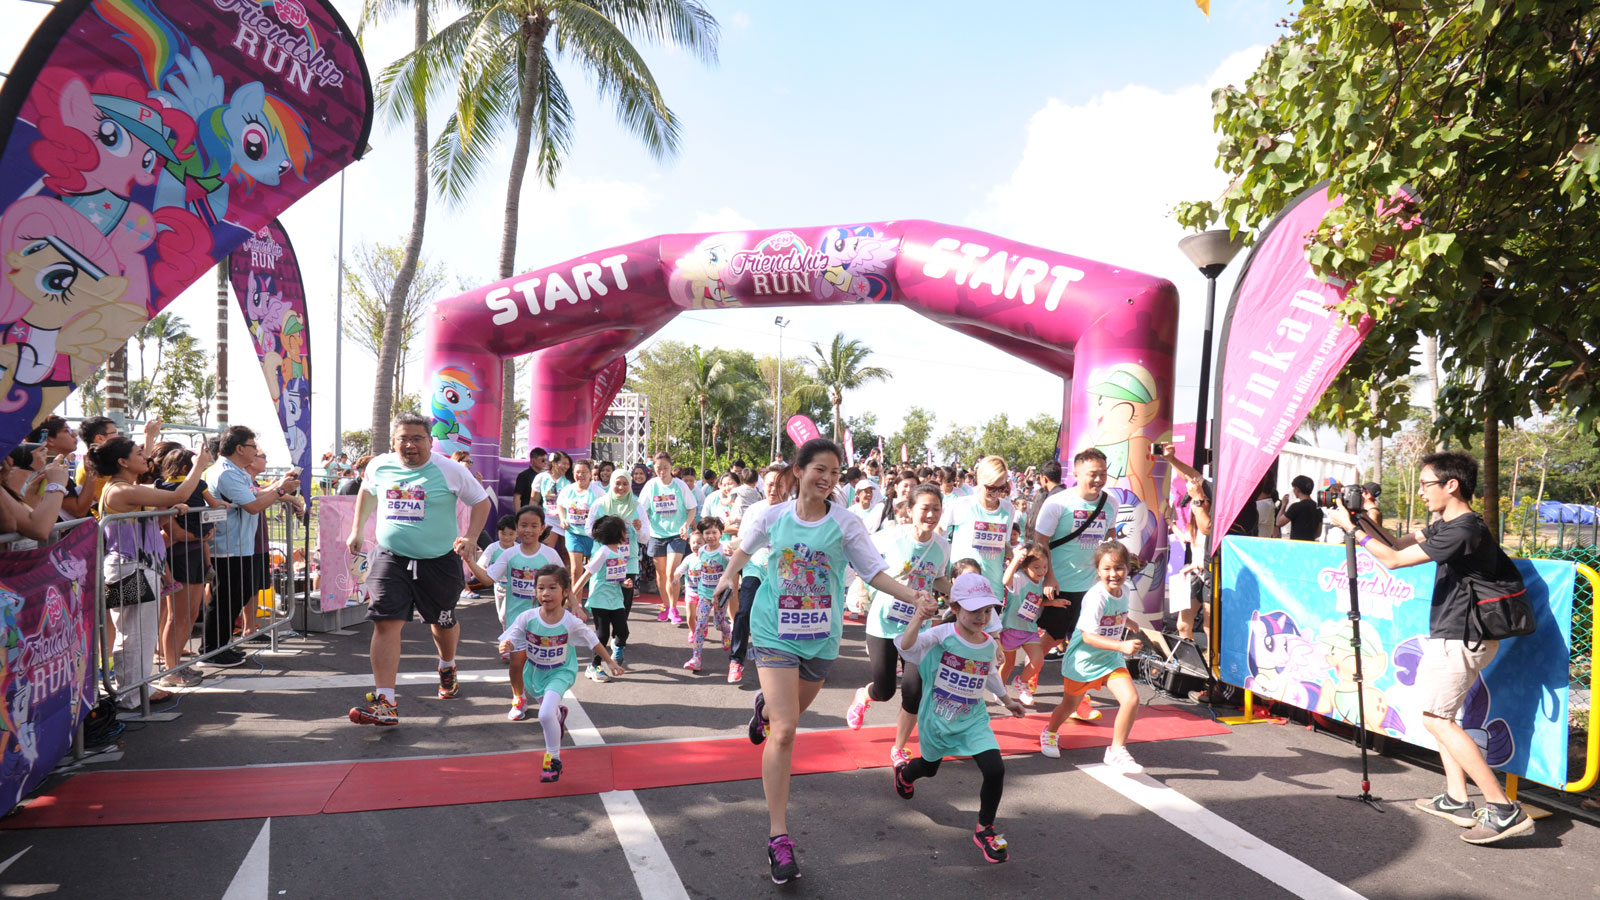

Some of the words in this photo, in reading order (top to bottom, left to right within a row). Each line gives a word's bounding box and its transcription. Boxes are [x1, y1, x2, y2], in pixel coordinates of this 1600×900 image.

[275, 1, 308, 25] PONY
[214, 0, 343, 88] Friendship
[232, 22, 314, 94] RUN
[139, 107, 152, 121] P
[251, 251, 275, 270] RUN
[731, 246, 829, 279] Friendship
[752, 272, 811, 294] RUN
[922, 237, 1085, 312] START
[485, 253, 629, 326] START
[387, 500, 421, 510] 2674A
[512, 579, 537, 589] 2674
[1321, 569, 1411, 600] Frindship
[780, 611, 828, 624] 2926A
[892, 601, 917, 615] 236
[527, 643, 564, 658] 2736B
[33, 652, 74, 704] RUN
[939, 667, 984, 689] 2926B
[935, 704, 954, 721] RU
